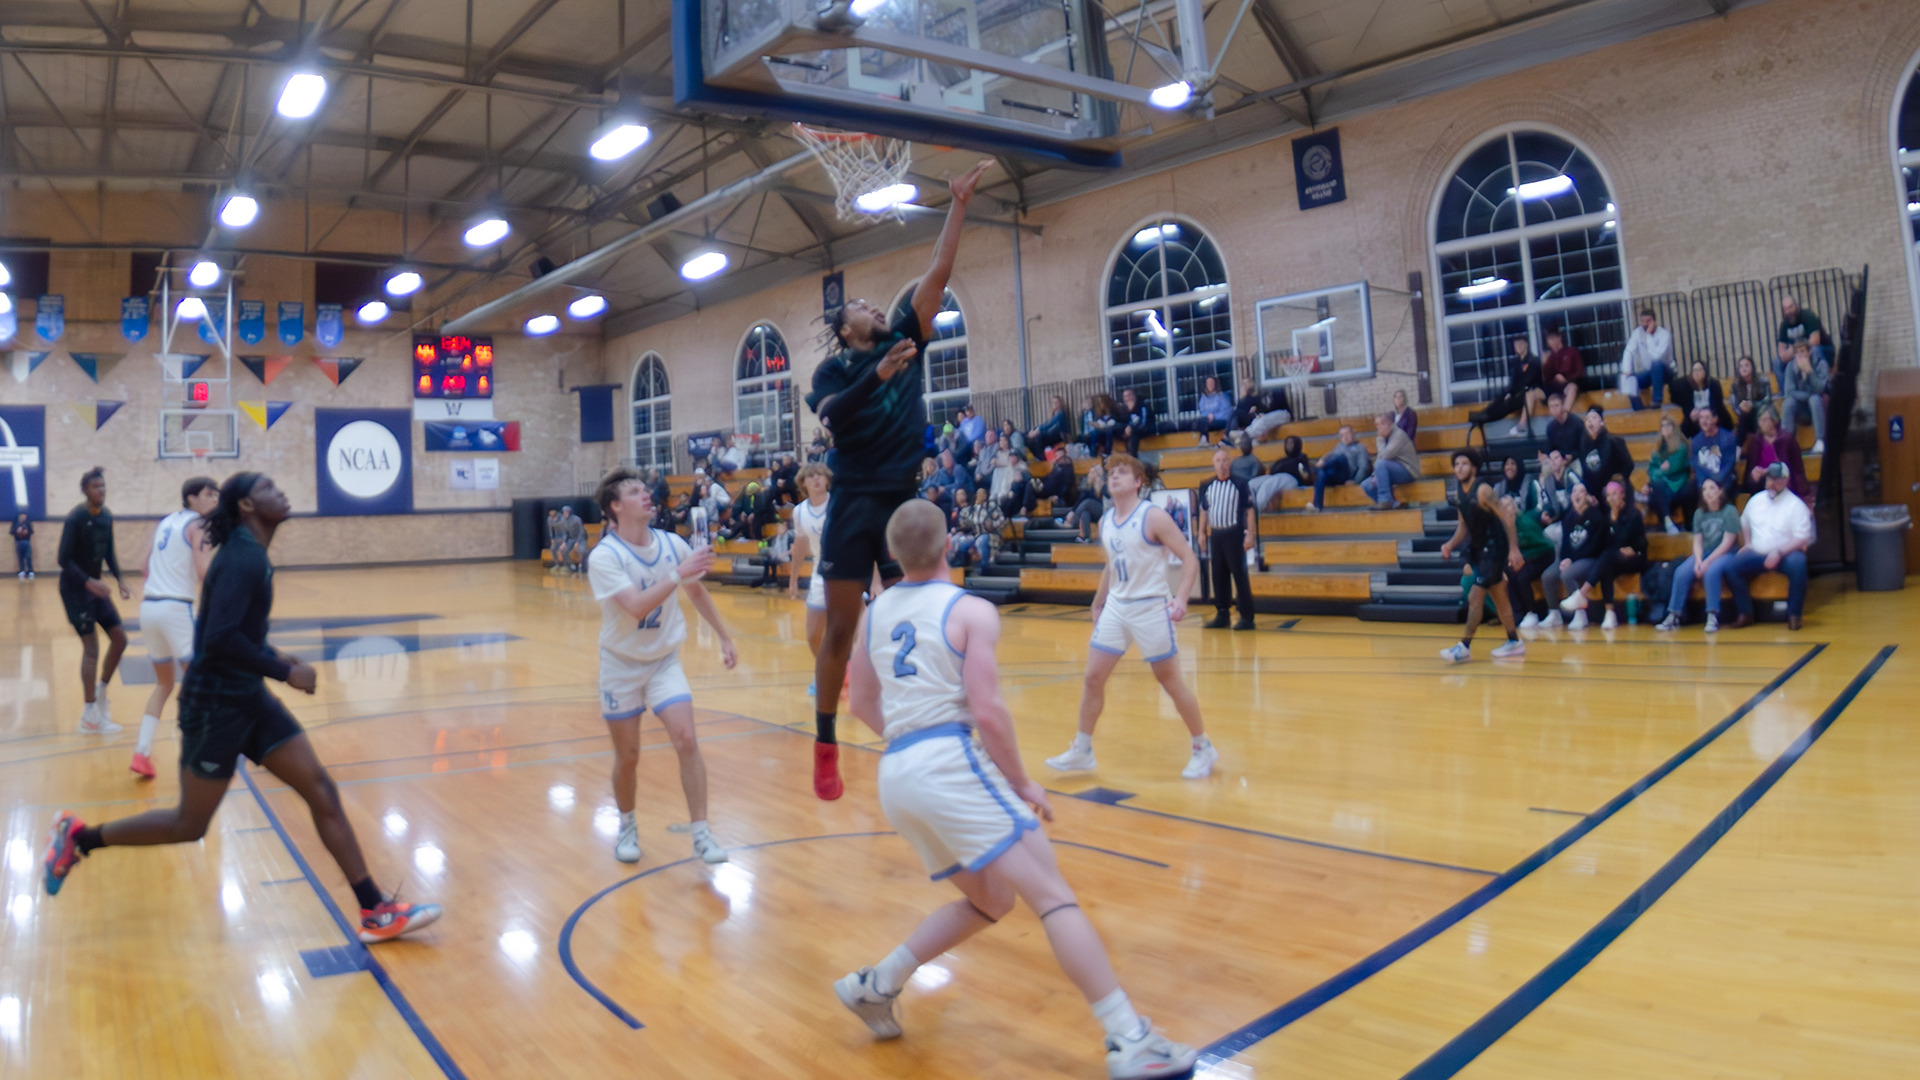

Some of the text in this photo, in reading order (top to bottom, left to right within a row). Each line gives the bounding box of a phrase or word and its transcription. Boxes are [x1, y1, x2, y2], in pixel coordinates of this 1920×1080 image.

[339, 447, 391, 471] NCAA
[1114, 558, 1128, 583] 11
[890, 620, 918, 678] 2
